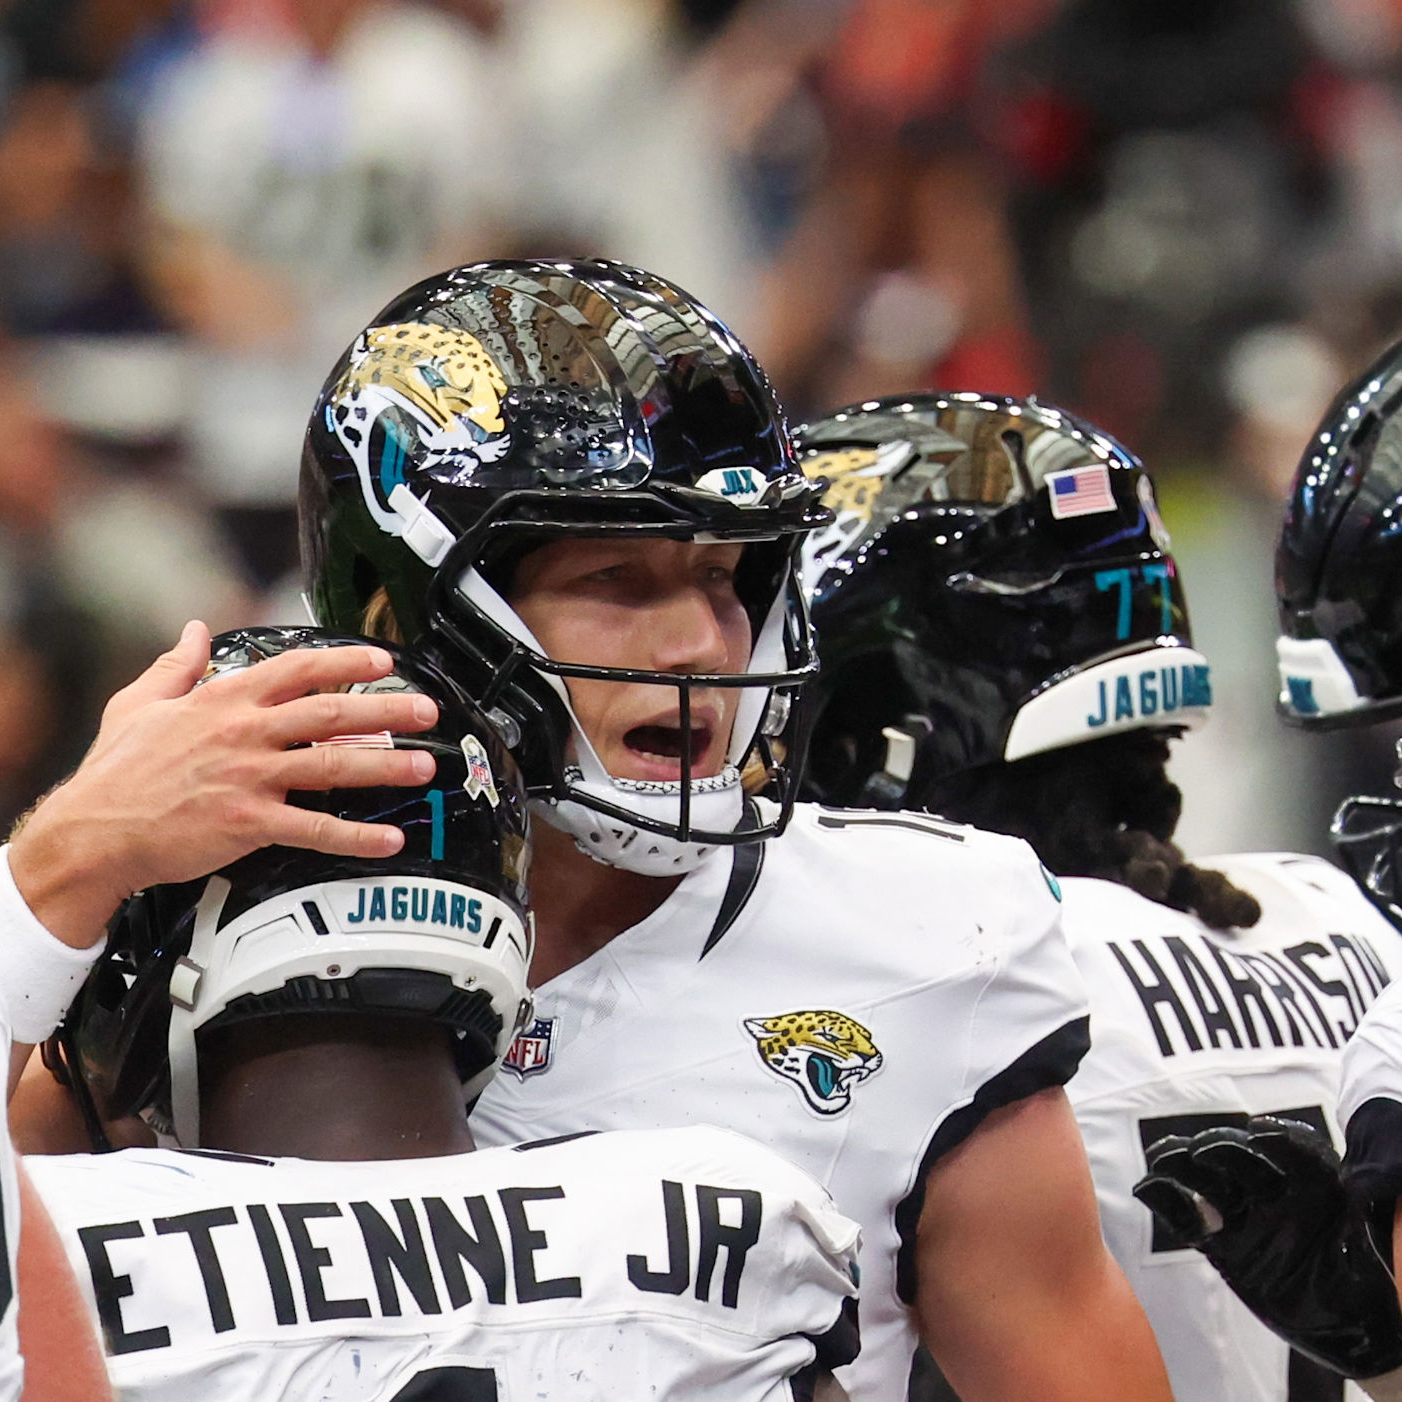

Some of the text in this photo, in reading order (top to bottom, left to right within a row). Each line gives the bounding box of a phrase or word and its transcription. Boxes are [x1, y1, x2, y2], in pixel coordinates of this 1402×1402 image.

[1094, 563, 1174, 640] 77
[470, 763, 491, 784] NFL
[426, 789, 445, 861] 1
[348, 886, 483, 935] JAGUARS
[505, 1038, 544, 1068] NFL
[77, 1179, 763, 1356] ETIENNE JR
